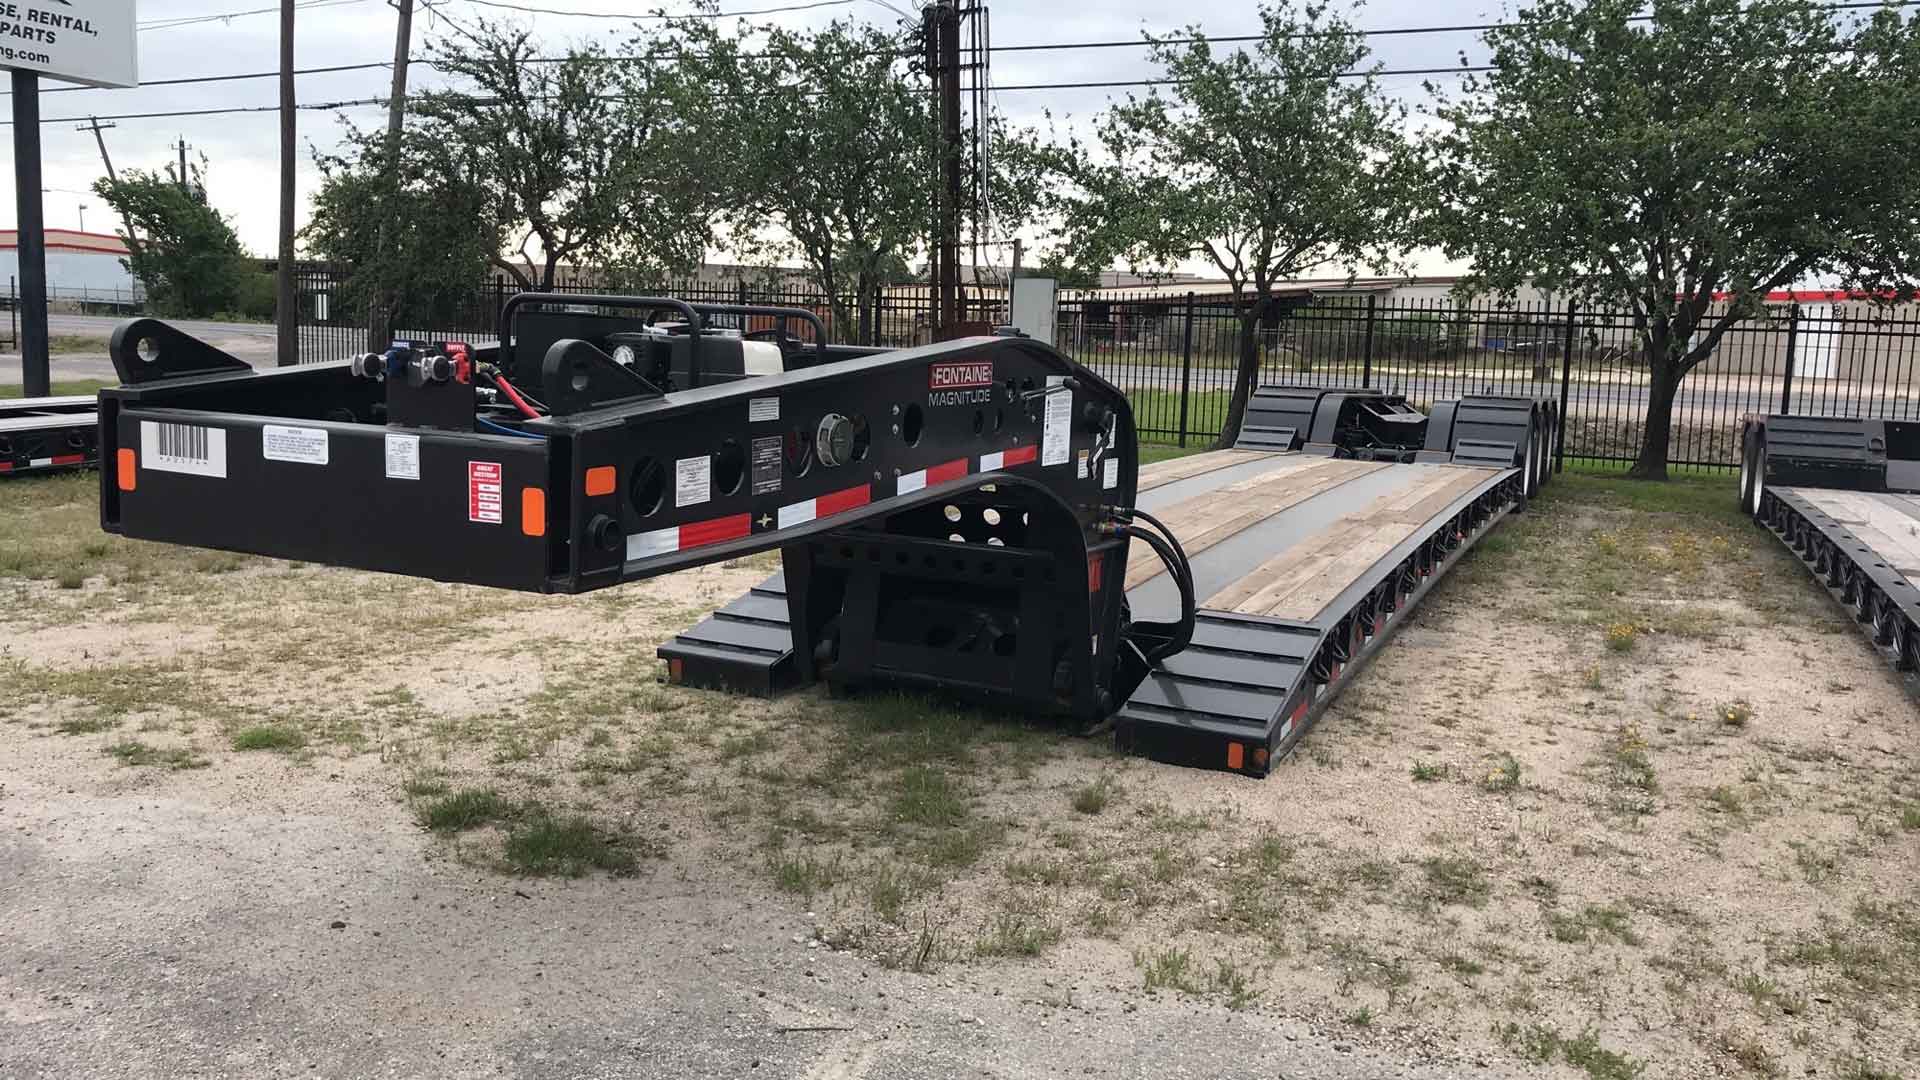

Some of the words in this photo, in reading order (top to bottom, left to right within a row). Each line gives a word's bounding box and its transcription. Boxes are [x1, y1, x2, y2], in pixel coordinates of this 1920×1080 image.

[0, 21, 57, 44] PARTS
[27, 8, 98, 37] RENTAL,
[935, 365, 989, 385] FONTAINE
[928, 388, 991, 408] MAGNITUDE
